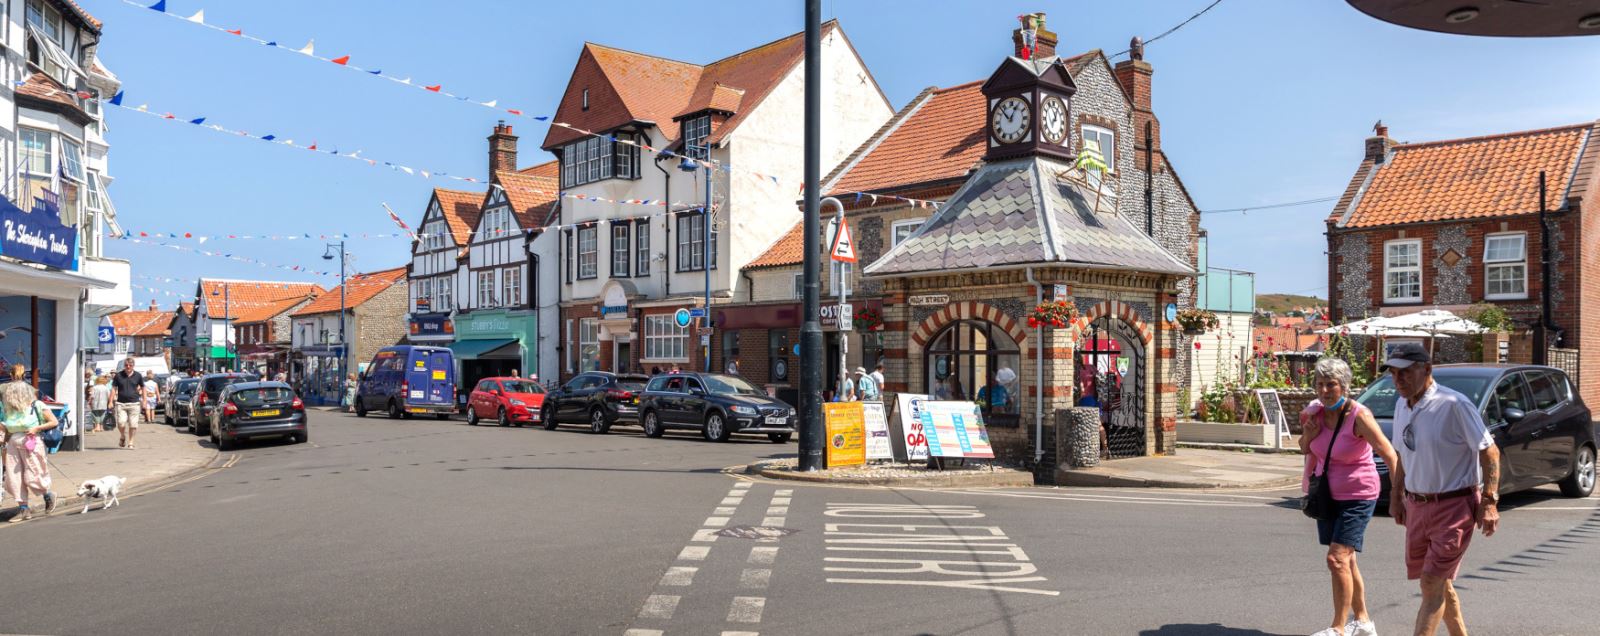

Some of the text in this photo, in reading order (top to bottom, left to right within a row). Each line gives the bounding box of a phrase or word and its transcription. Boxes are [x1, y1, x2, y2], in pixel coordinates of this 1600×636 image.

[4, 219, 16, 241] The
[910, 297, 925, 305] HIGH
[925, 296, 948, 304] STREET
[818, 304, 839, 318] OST
[823, 502, 987, 519] NO
[823, 523, 1060, 596] ENTRY
